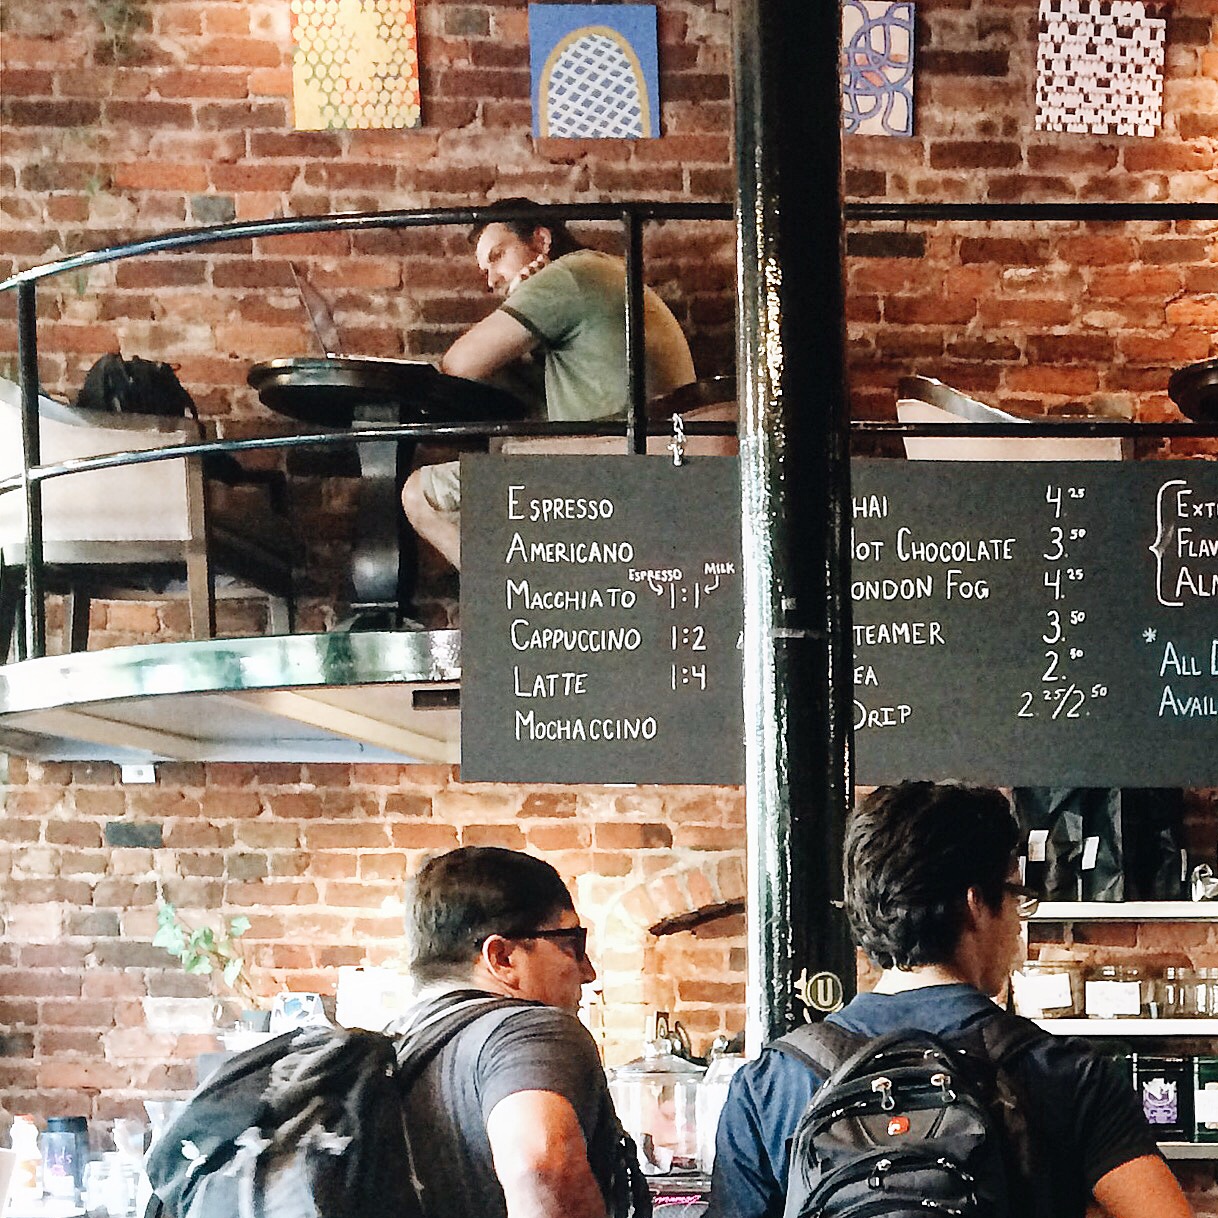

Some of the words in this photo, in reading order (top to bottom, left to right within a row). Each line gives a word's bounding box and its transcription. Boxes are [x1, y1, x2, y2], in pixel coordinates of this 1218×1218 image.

[508, 485, 615, 522] ESPRESSO
[852, 495, 889, 518] HAI
[505, 532, 635, 564] AMERICANO
[897, 527, 1017, 562] CHOCOLATE
[628, 569, 683, 582] ESPRESSO
[704, 562, 736, 575] MILK
[505, 580, 637, 611] MACCHIATO
[669, 582, 701, 610] 1:1
[851, 575, 933, 600] ONDON
[947, 569, 990, 600] FOG
[510, 619, 642, 651] CAPPUCCINO
[670, 625, 707, 652] 1:2
[852, 621, 946, 646] TEAMER
[1159, 641, 1202, 677] ALL
[514, 666, 588, 698] LATTE
[671, 664, 708, 691] 1:4
[852, 664, 879, 687] EA
[514, 710, 658, 742] MOCHACCINO
